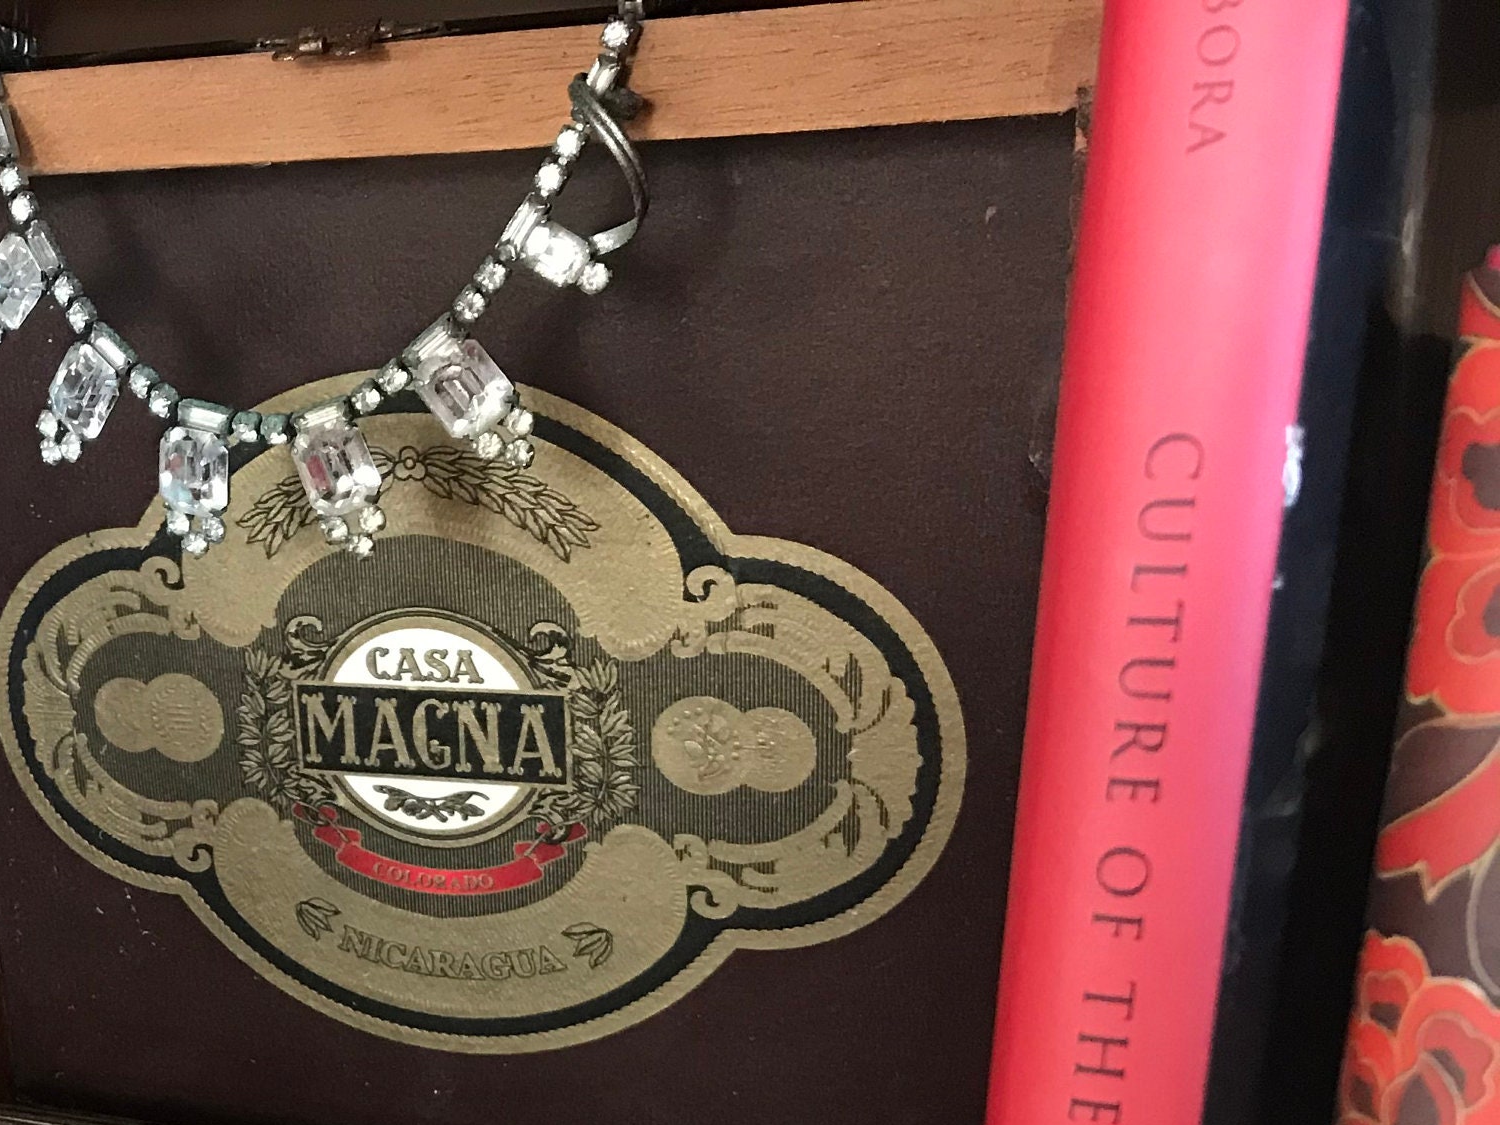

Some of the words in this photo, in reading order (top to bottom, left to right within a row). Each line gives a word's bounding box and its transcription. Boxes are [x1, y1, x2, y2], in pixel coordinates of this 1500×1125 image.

[1105, 432, 1205, 805] CULTURE
[365, 646, 485, 684] CASA
[301, 691, 563, 779] MAGNA
[372, 862, 495, 890] COLORADO
[1090, 846, 1154, 943] OF
[337, 924, 568, 981] NICARAGUA
